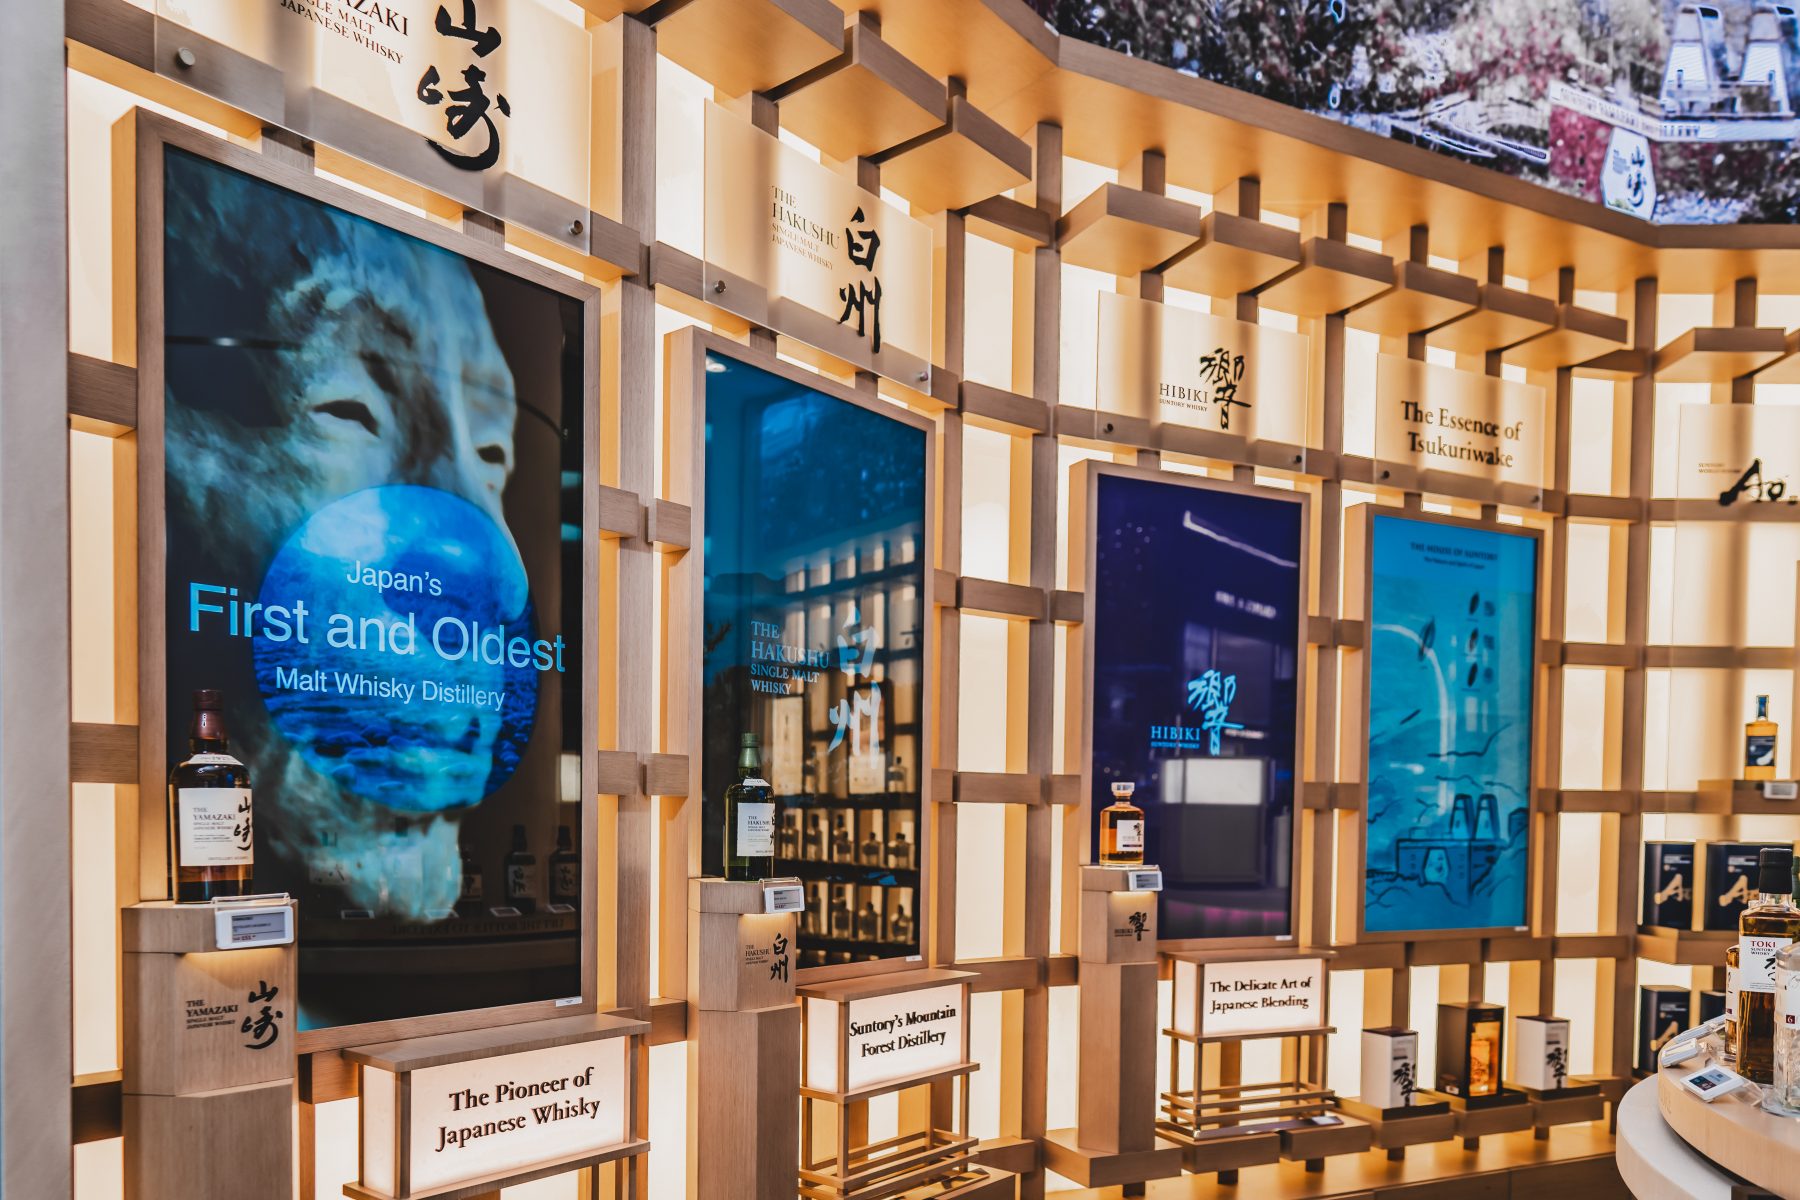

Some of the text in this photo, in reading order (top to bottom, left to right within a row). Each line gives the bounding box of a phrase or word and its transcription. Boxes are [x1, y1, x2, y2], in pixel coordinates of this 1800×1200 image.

[338, 8, 375, 34] MALT
[353, 31, 403, 64] WHISKY
[771, 185, 797, 208] THE
[773, 203, 840, 249] HAKUSHU
[1159, 382, 1209, 404] HIBIKI
[1401, 400, 1523, 441] The Essence of
[1407, 431, 1513, 467] Tsukuriwake
[189, 582, 566, 673] First and Oldest
[751, 621, 780, 639] THE
[751, 641, 830, 669] HAKUSHU
[751, 663, 820, 684] SINGLE MALT
[276, 666, 505, 712] Malt Whisky Distillery
[751, 679, 792, 695] WHISKY
[1151, 725, 1200, 741] HIBIKI
[1751, 940, 1776, 948] TOKI
[1210, 976, 1313, 993] The Delicate Art of
[186, 999, 205, 1008] THE
[186, 1004, 239, 1017] YAMAZAKI
[905, 1004, 956, 1026] Mountain
[1209, 995, 1309, 1015] Japanese Blending
[861, 1030, 946, 1057] Forest Distillery
[449, 1066, 595, 1111] The Pioneer of
[434, 1096, 601, 1152] Japanese Whisky
